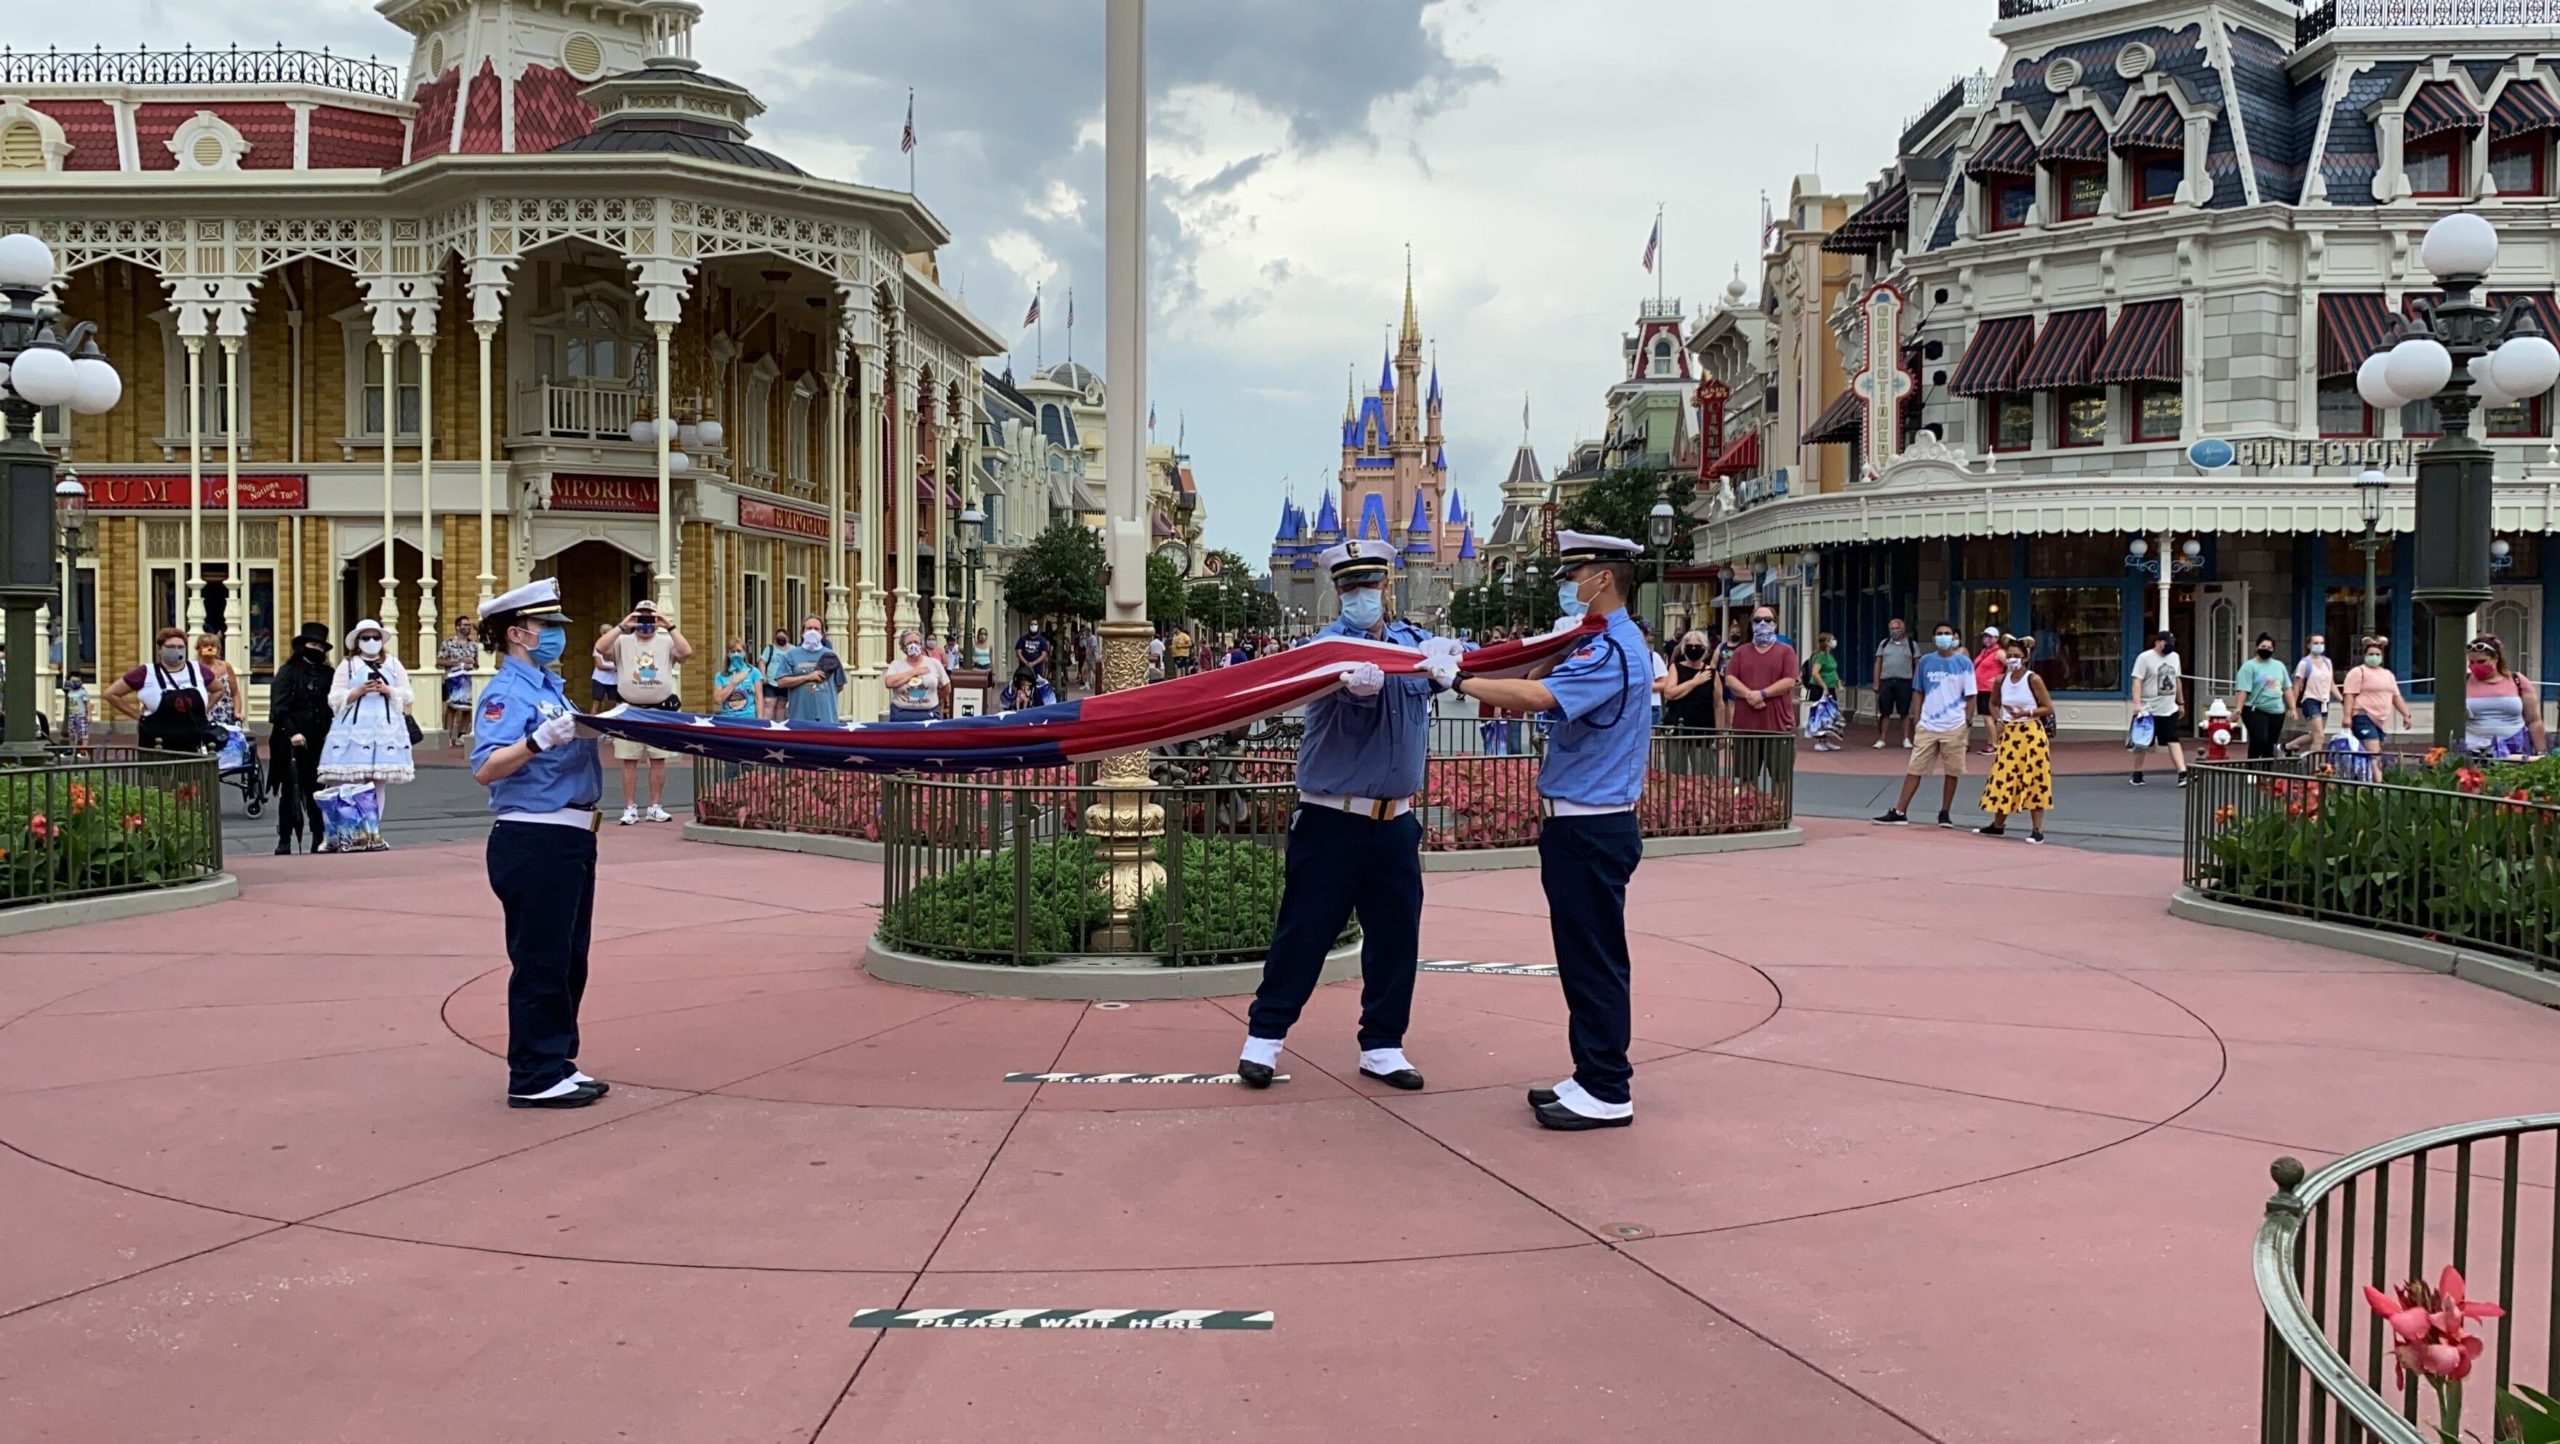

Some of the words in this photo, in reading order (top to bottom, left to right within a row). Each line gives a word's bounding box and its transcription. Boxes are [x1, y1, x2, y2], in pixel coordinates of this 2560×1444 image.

[1877, 304, 1889, 468] CONFECTIONERY
[1707, 402, 1720, 459] CINEM
[2236, 439, 2431, 466] CONFECTIONE
[87, 480, 168, 502] IUM
[250, 481, 280, 501] Notions
[552, 479, 658, 503] MPORIUM
[775, 510, 830, 537] EMPORIU
[915, 1318, 1023, 1328] PLEASE
[1039, 1318, 1115, 1328] WAIT
[1128, 1319, 1203, 1329] HERE
